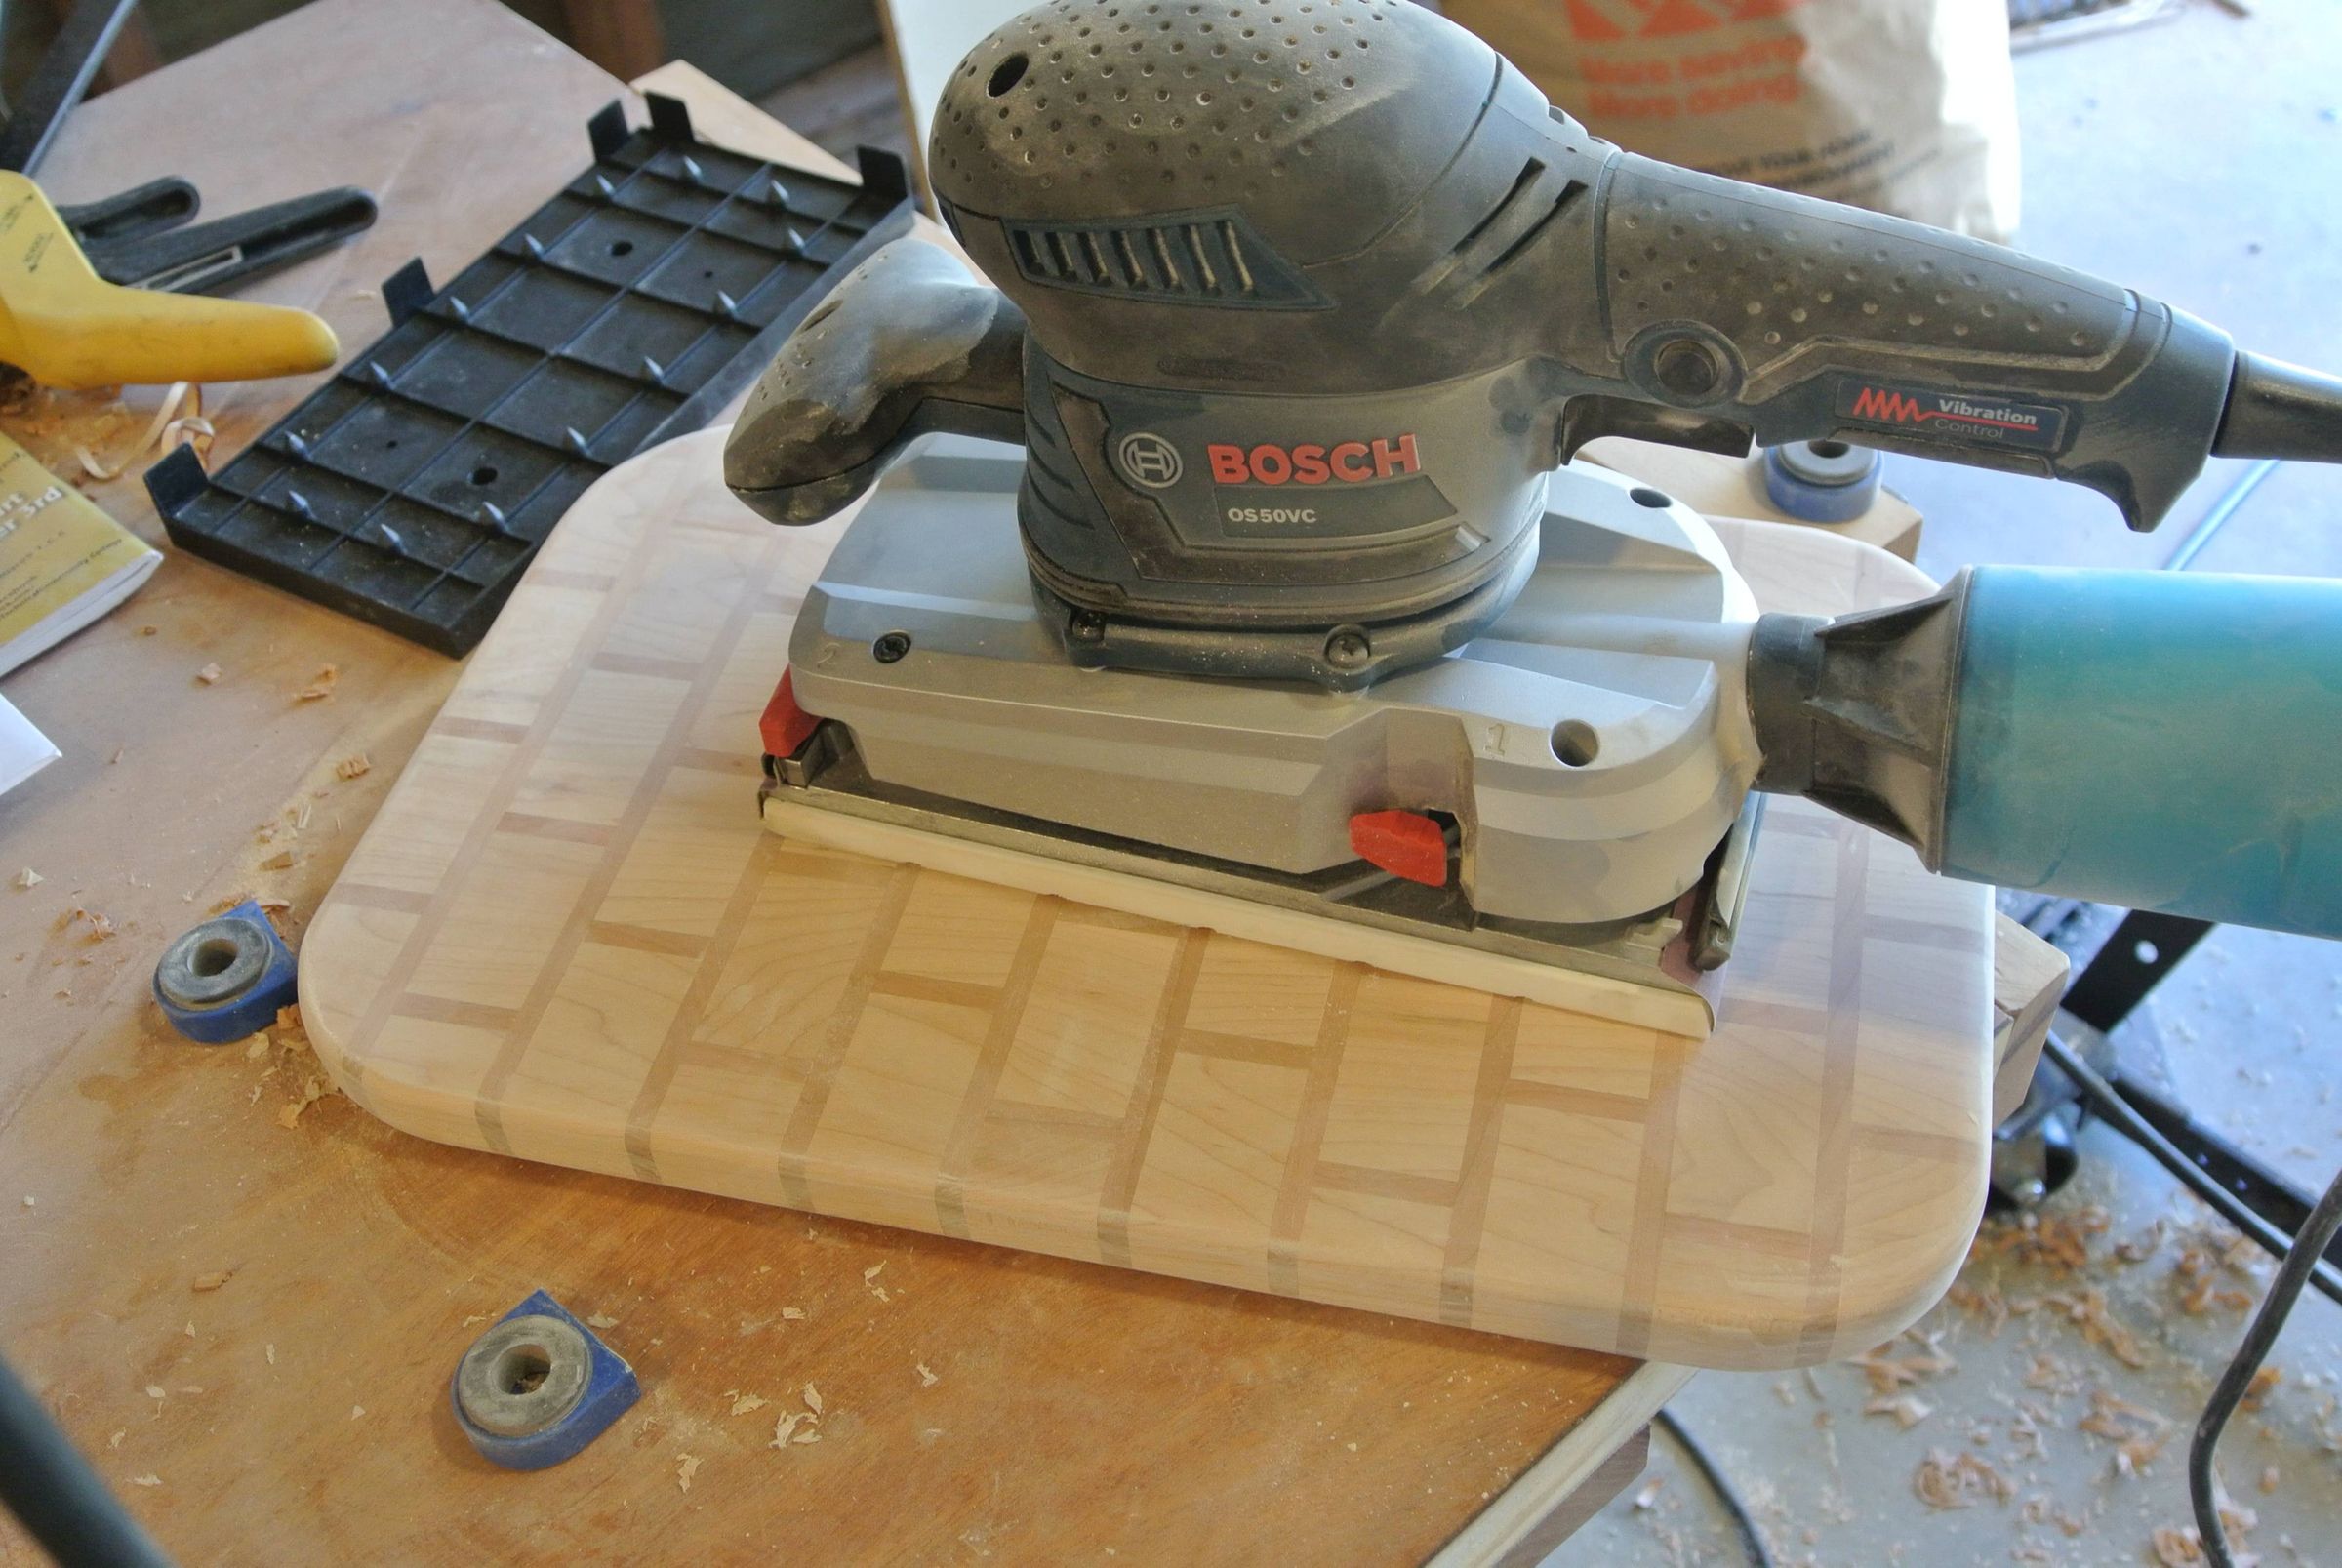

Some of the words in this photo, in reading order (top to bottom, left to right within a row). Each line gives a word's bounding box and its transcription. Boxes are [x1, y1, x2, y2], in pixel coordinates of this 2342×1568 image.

[1938, 398, 2038, 426] Vibration
[1934, 418, 2004, 439] Control
[1207, 433, 1422, 486] BOSCH
[1227, 507, 1317, 524] OS50VC
[1483, 722, 1506, 757] 1
